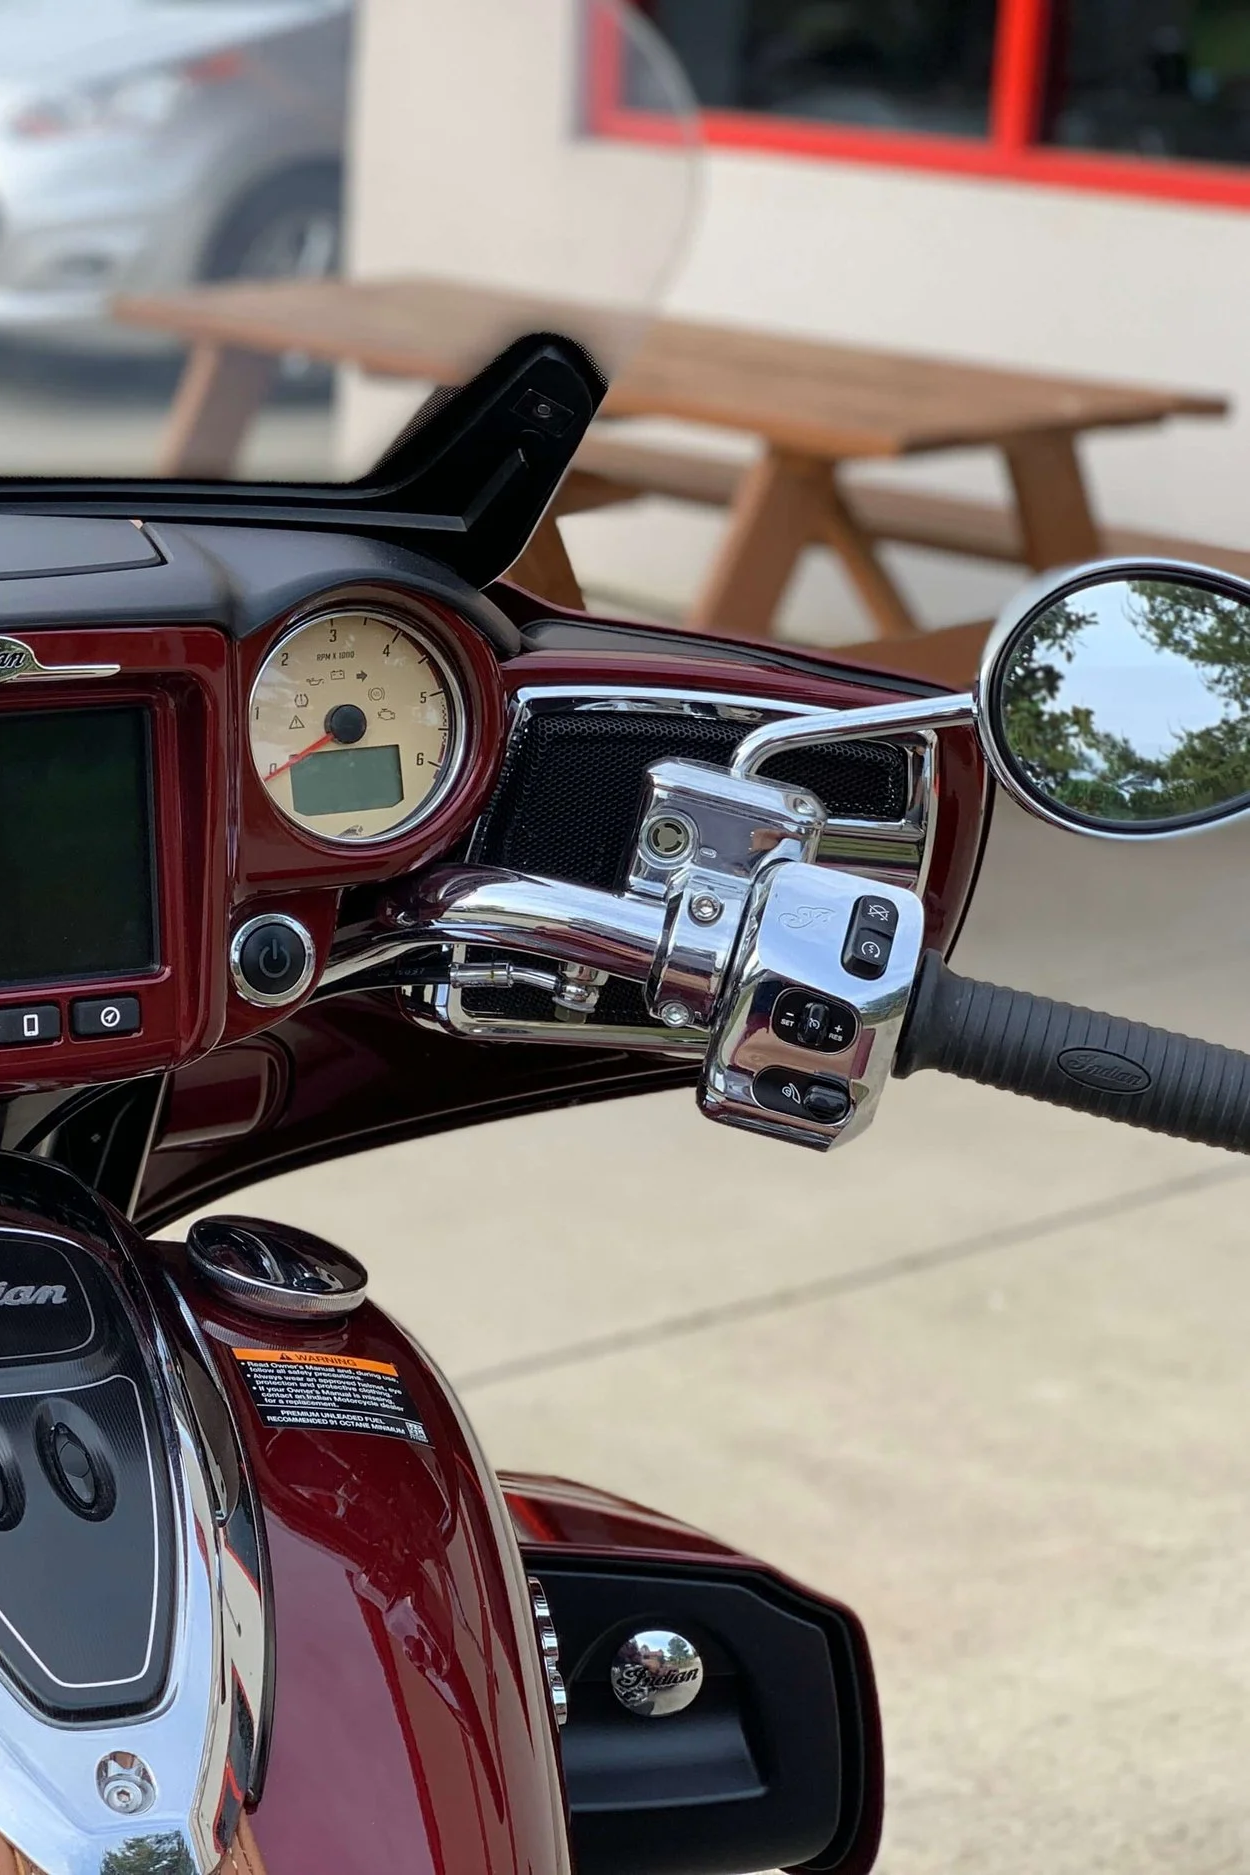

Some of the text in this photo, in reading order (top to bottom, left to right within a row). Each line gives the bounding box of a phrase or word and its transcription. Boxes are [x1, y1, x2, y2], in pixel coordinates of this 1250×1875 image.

[329, 629, 337, 643] 3
[316, 653, 331, 662] RPM
[338, 651, 355, 660] 1000
[382, 644, 391, 657] 4
[281, 652, 289, 667] 2
[420, 692, 427, 704] 5
[254, 706, 260, 720] 1
[416, 752, 424, 766] 6
[780, 1018, 795, 1027] SET
[829, 1033, 843, 1042] RES
[295, 1353, 357, 1366] WARNING
[280, 1410, 386, 1425] PREMIUM UNLEADED FUEL
[266, 1415, 329, 1425] RECOMMENDED
[339, 1420, 371, 1429] OCTANE
[371, 1423, 406, 1435] MINIMUM
[617, 1665, 699, 1688] Indian
